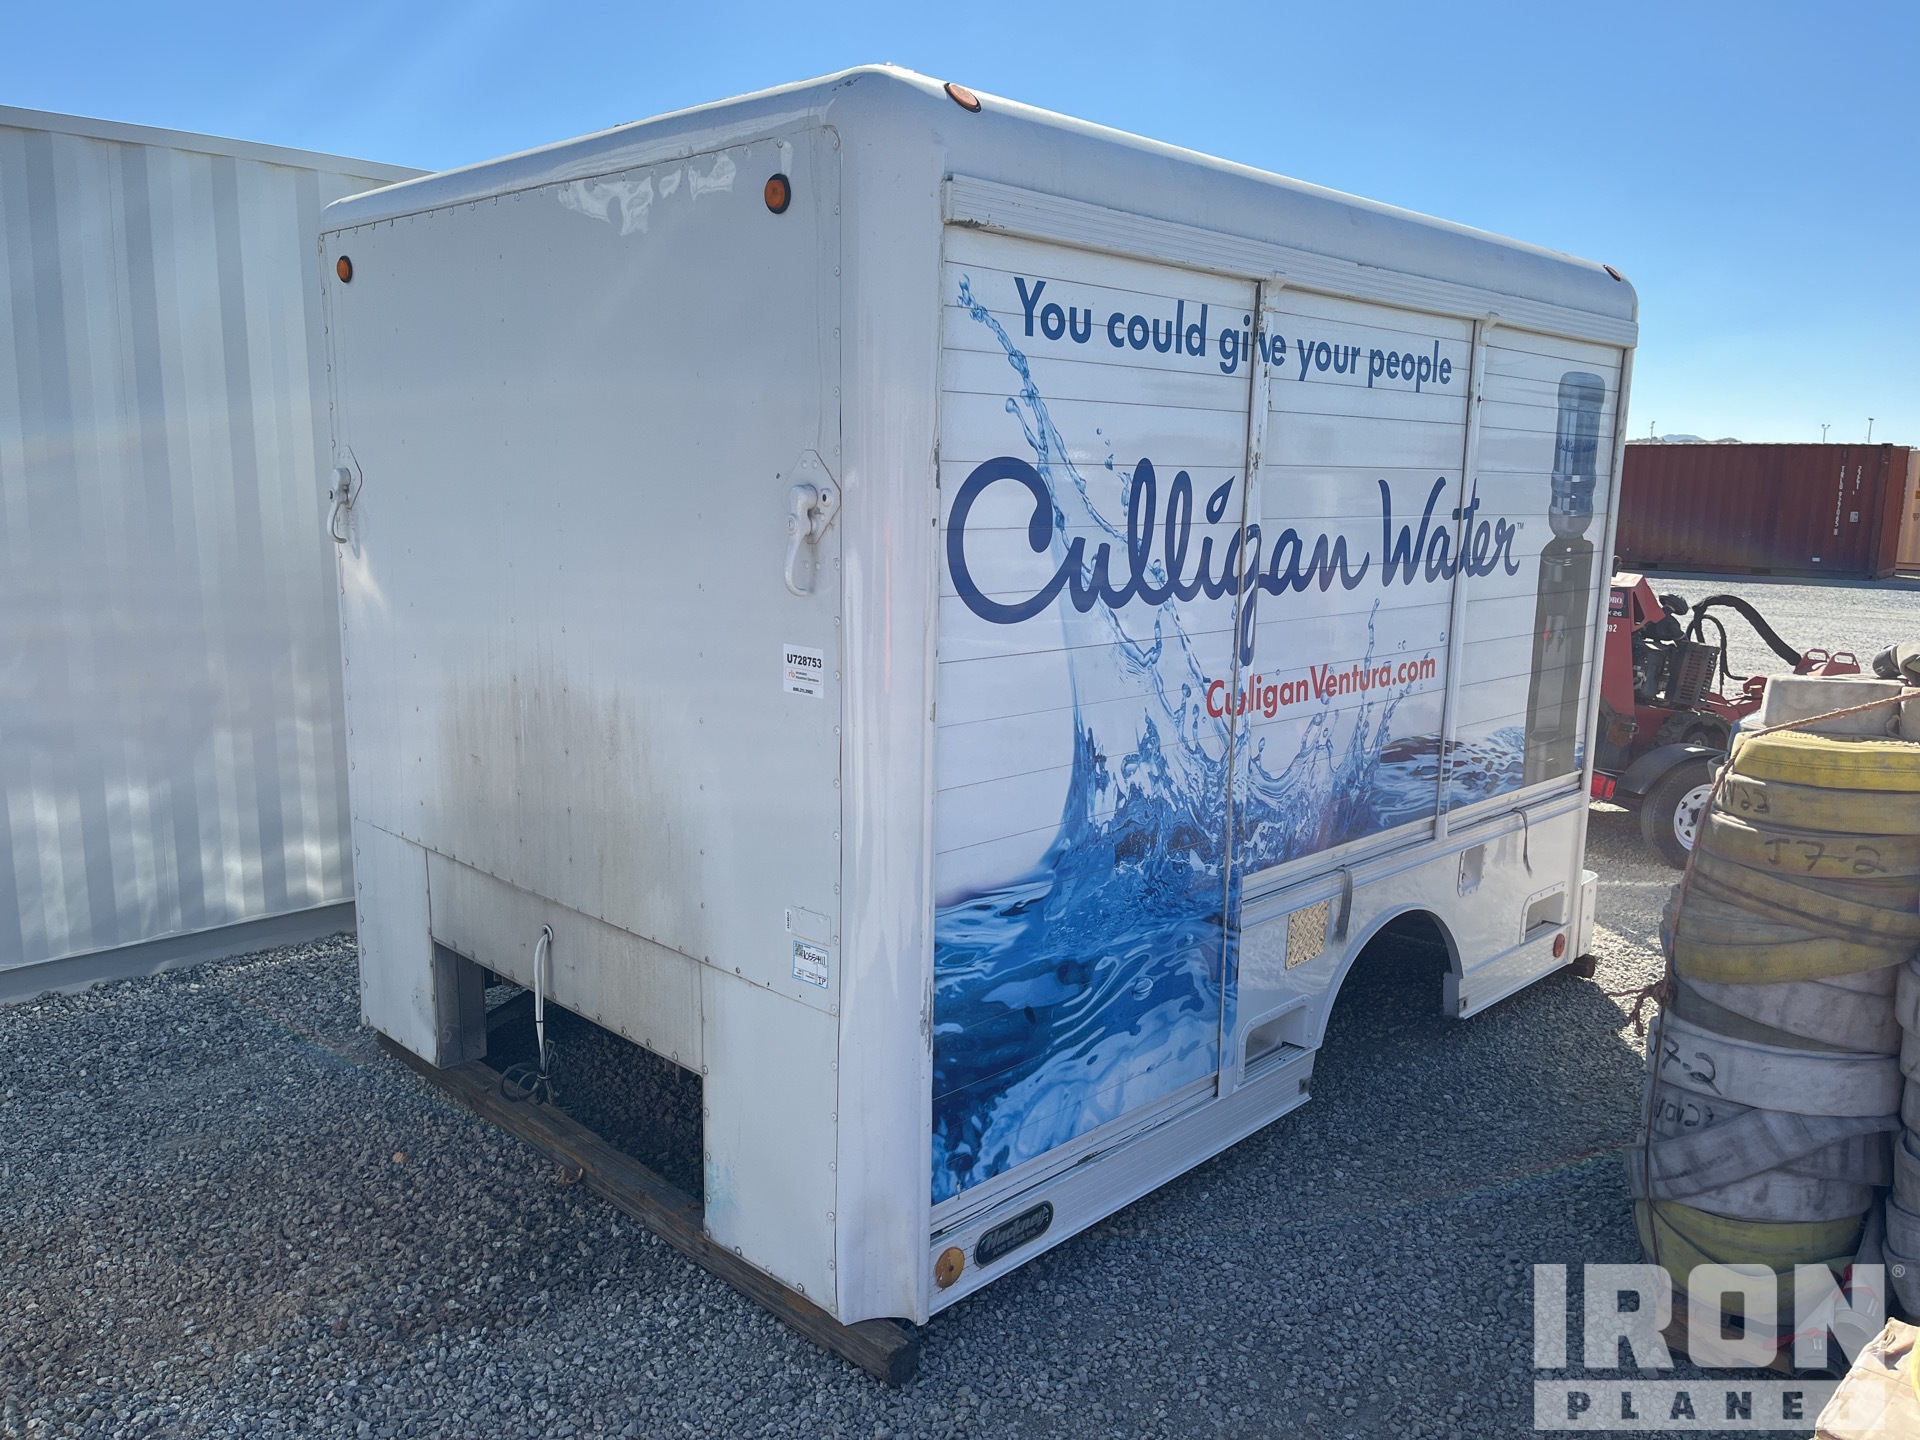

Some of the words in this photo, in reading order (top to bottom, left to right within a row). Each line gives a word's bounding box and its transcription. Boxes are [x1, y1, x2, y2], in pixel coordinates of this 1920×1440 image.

[1014, 276, 1093, 344] You
[1107, 299, 1208, 357] could
[1219, 314, 1287, 375] give
[1297, 337, 1362, 382] your
[1368, 339, 1453, 393] people
[946, 456, 1371, 667] Culligan
[1377, 475, 1520, 587] Water
[1609, 596, 1622, 604] RO
[786, 653, 822, 669] U728753
